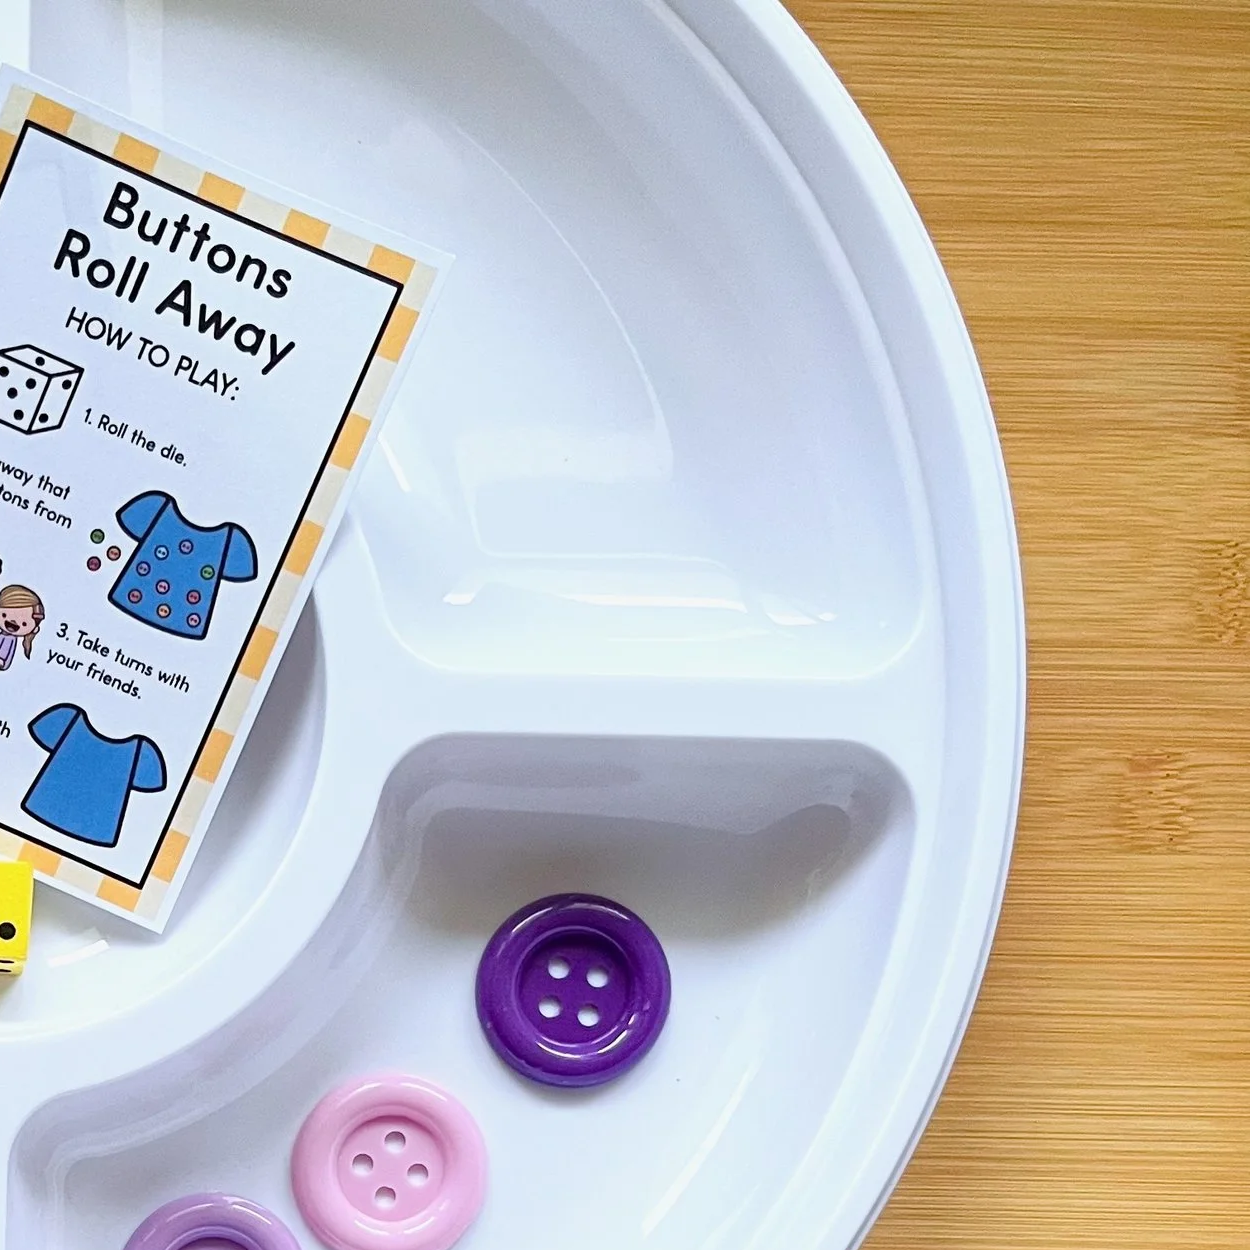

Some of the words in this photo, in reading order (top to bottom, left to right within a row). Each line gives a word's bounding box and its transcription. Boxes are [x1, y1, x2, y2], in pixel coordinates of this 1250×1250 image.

[102, 181, 292, 298] Buttons
[53, 228, 150, 304] Roll
[154, 279, 296, 376] Away
[65, 306, 133, 351] HOW
[137, 337, 170, 368] TO
[174, 355, 240, 401] PLAY:
[84, 408, 93, 425] 1.
[97, 414, 129, 439] Roll
[130, 430, 156, 453] the
[160, 444, 188, 467] die.
[34, 502, 73, 529] from
[38, 475, 71, 500] that
[46, 649, 84, 675] your
[86, 660, 142, 700] friends.
[55, 622, 70, 642] 3.
[76, 629, 110, 658] Take
[114, 649, 153, 677] turns
[158, 667, 191, 693] with
